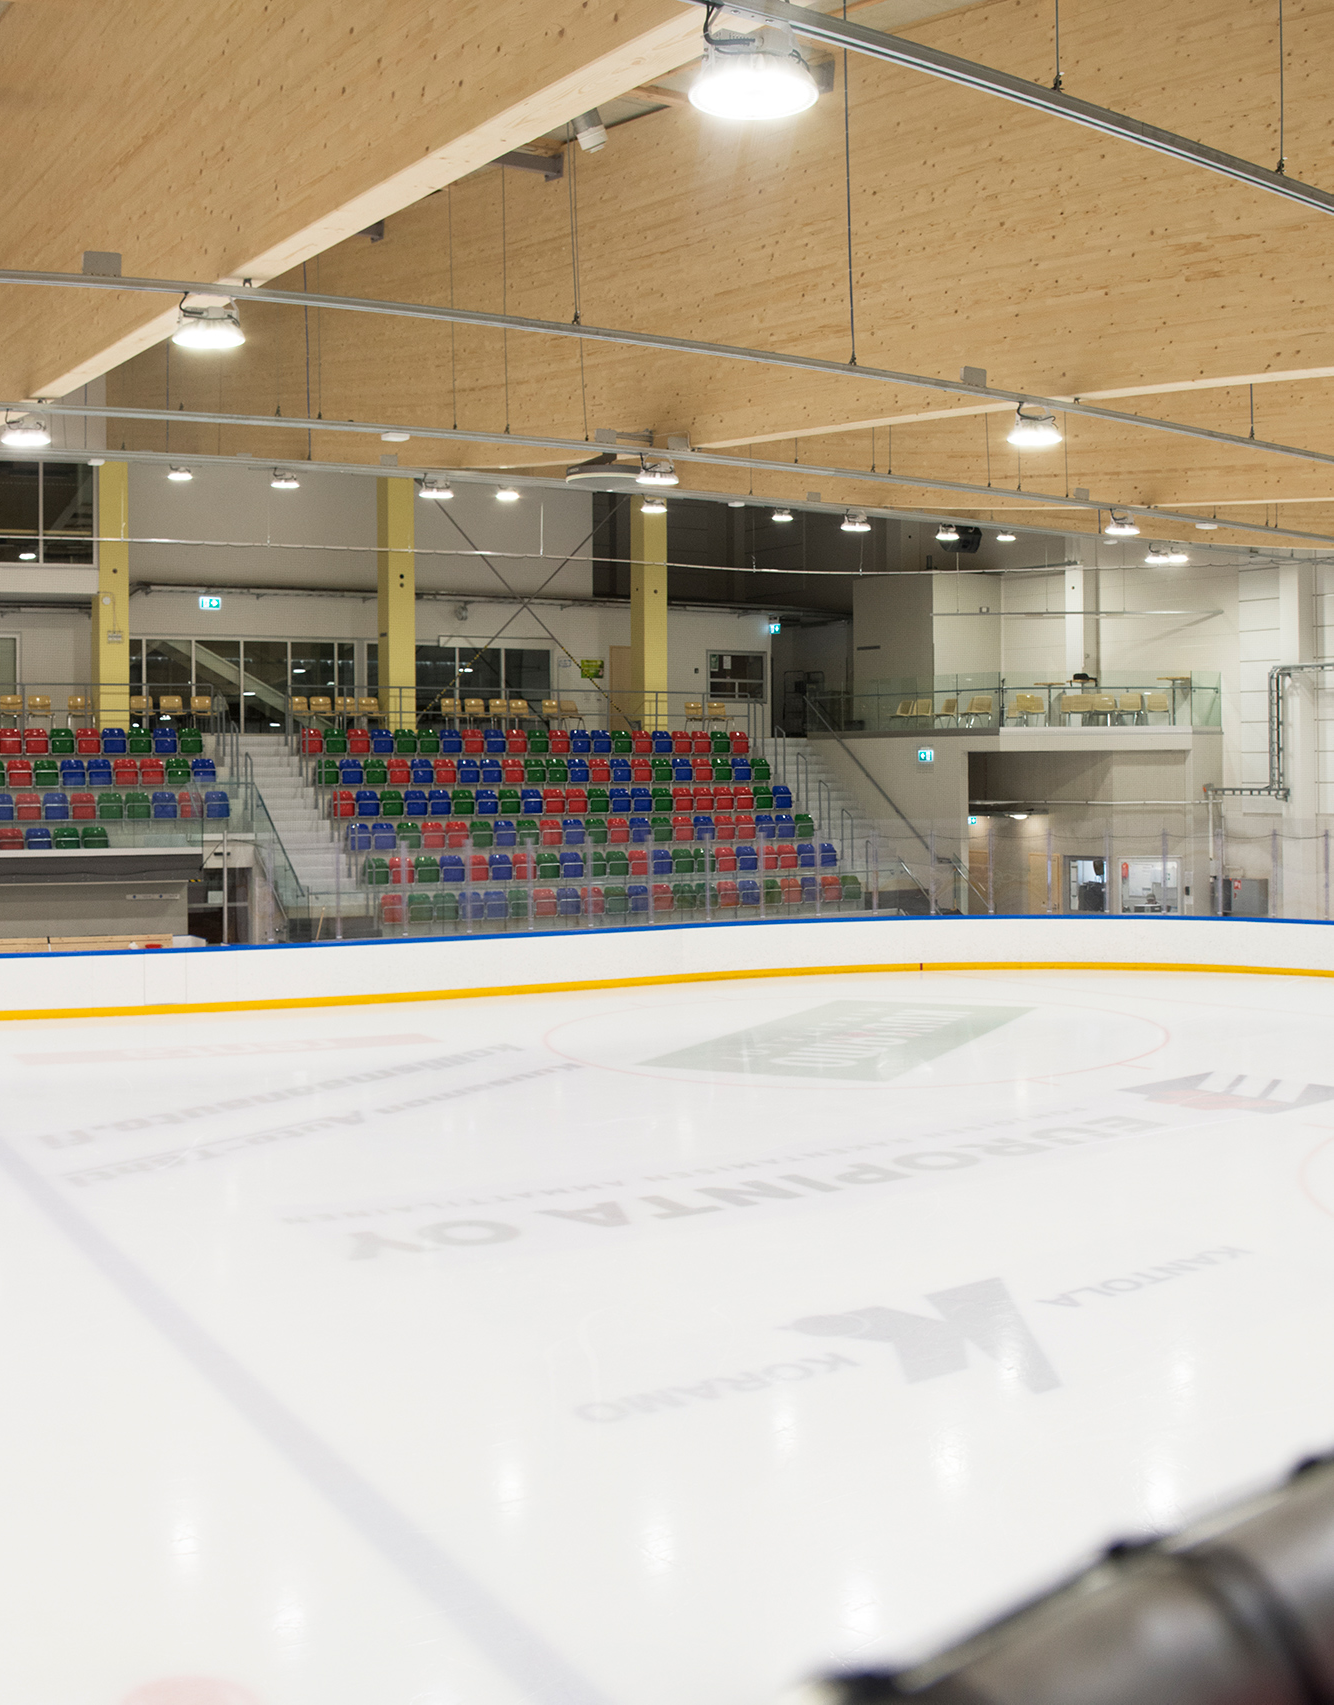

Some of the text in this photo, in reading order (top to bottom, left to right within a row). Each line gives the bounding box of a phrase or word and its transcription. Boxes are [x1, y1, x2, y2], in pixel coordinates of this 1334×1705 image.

[375, 1063, 585, 1114] Kuusamon
[347, 1115, 1167, 1260] EUROPINTA OY
[1036, 1245, 1254, 1310] KANTOLA
[574, 1352, 865, 1425] KORAMO
